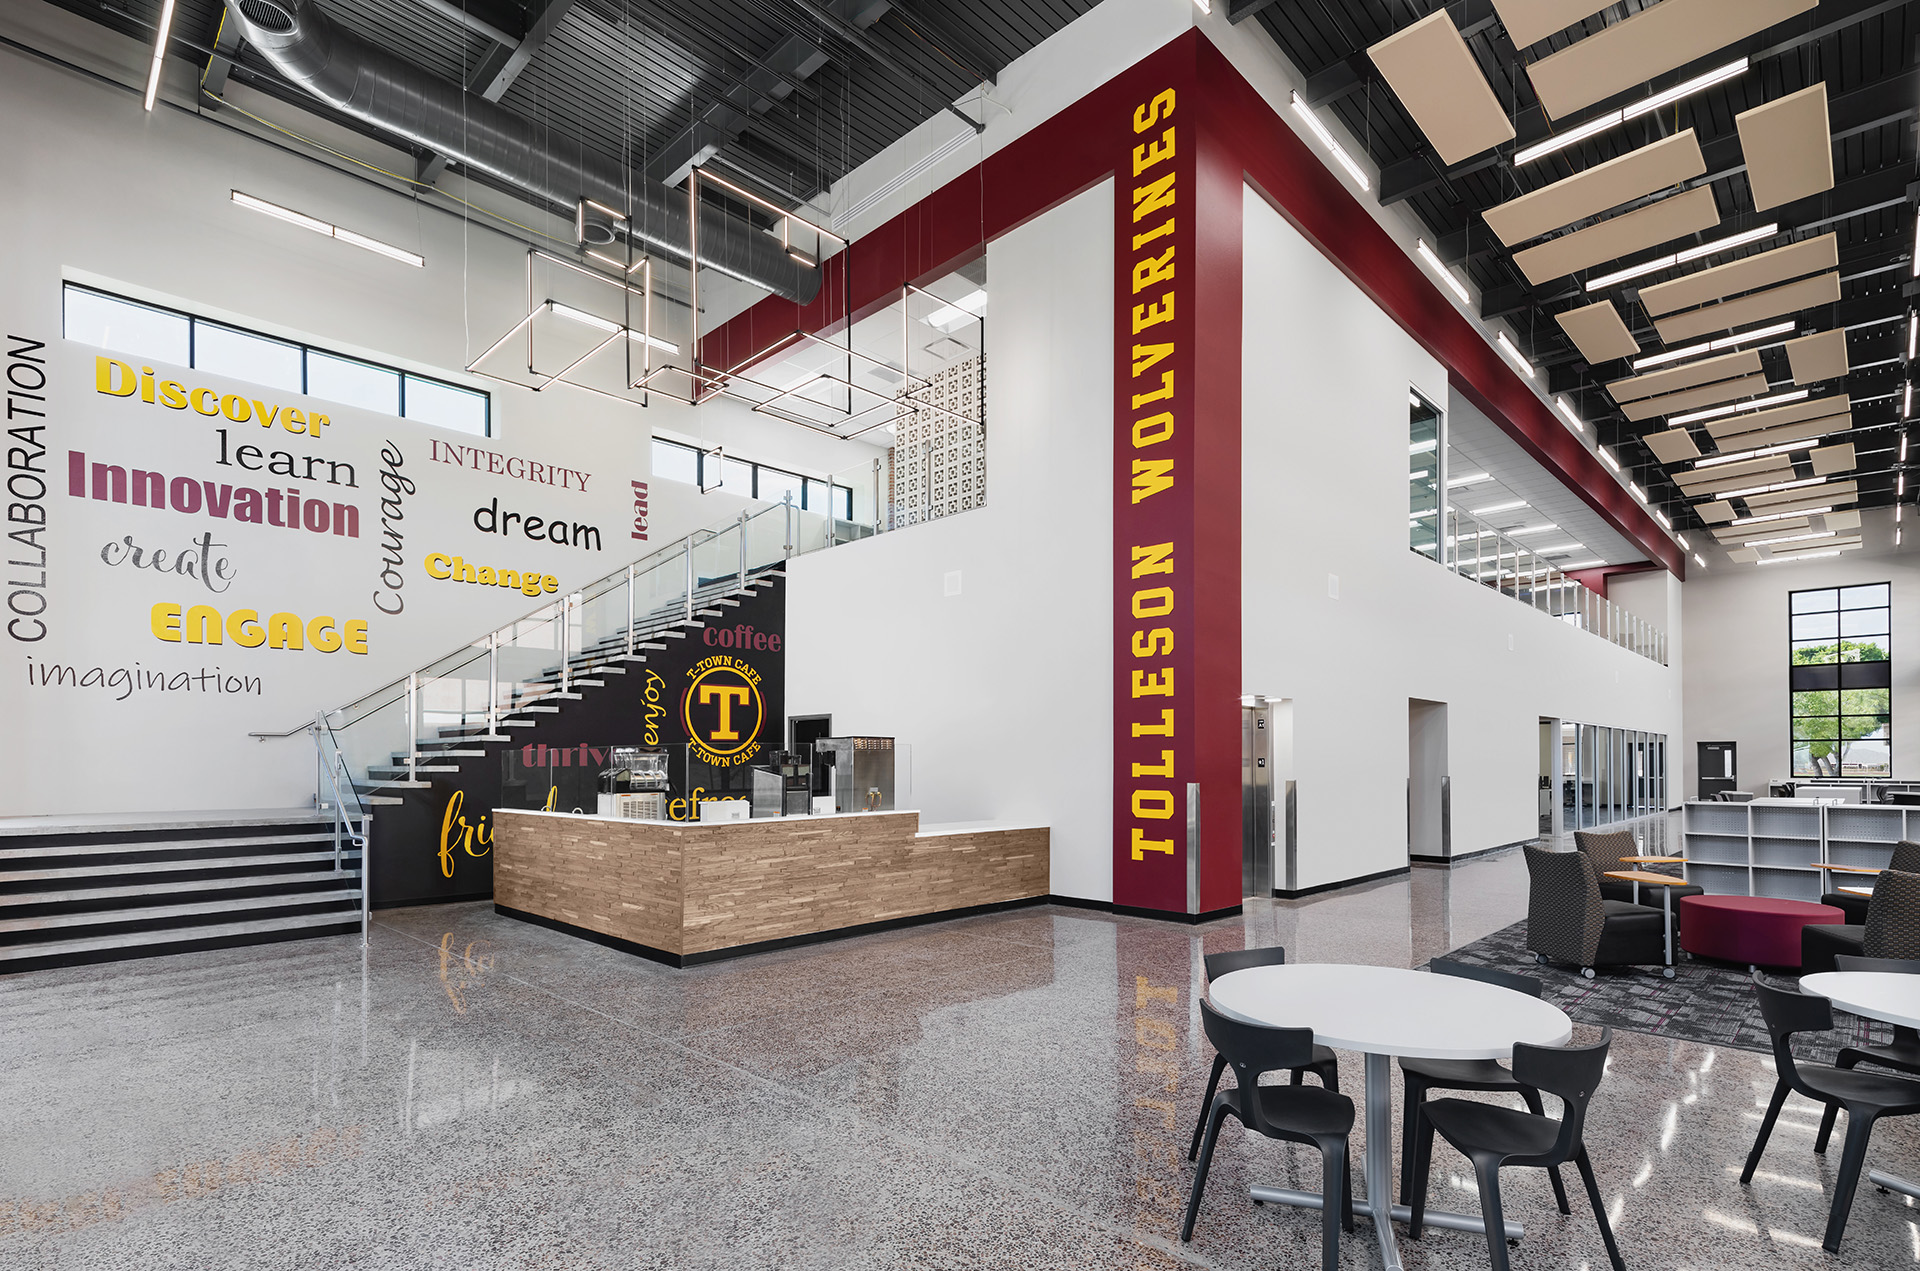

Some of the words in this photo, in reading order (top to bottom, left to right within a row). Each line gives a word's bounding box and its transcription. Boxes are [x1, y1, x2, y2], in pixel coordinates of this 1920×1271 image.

[1131, 87, 1176, 505] WOLVERINES
[95, 355, 331, 438] Discover
[215, 428, 360, 488] learn
[430, 438, 593, 493] INTEGRITY
[7, 334, 48, 643] COLLABORATION
[67, 450, 360, 539] Innovation
[630, 480, 649, 541] lead
[373, 438, 417, 616] Courage
[473, 497, 602, 552] dream
[100, 531, 238, 594] create
[423, 552, 560, 597] Change
[150, 602, 369, 655] ENGAGE
[702, 624, 782, 652] coffee
[26, 655, 263, 702] imagination
[686, 655, 732, 680] T-TOWN
[734, 659, 762, 685] CAFE
[640, 668, 667, 746] enjoy
[699, 684, 750, 741] T
[1131, 541, 1175, 861] TOLLESON
[520, 742, 615, 768] thriv
[688, 738, 731, 767] T-TOWN
[733, 741, 761, 765] CAFE
